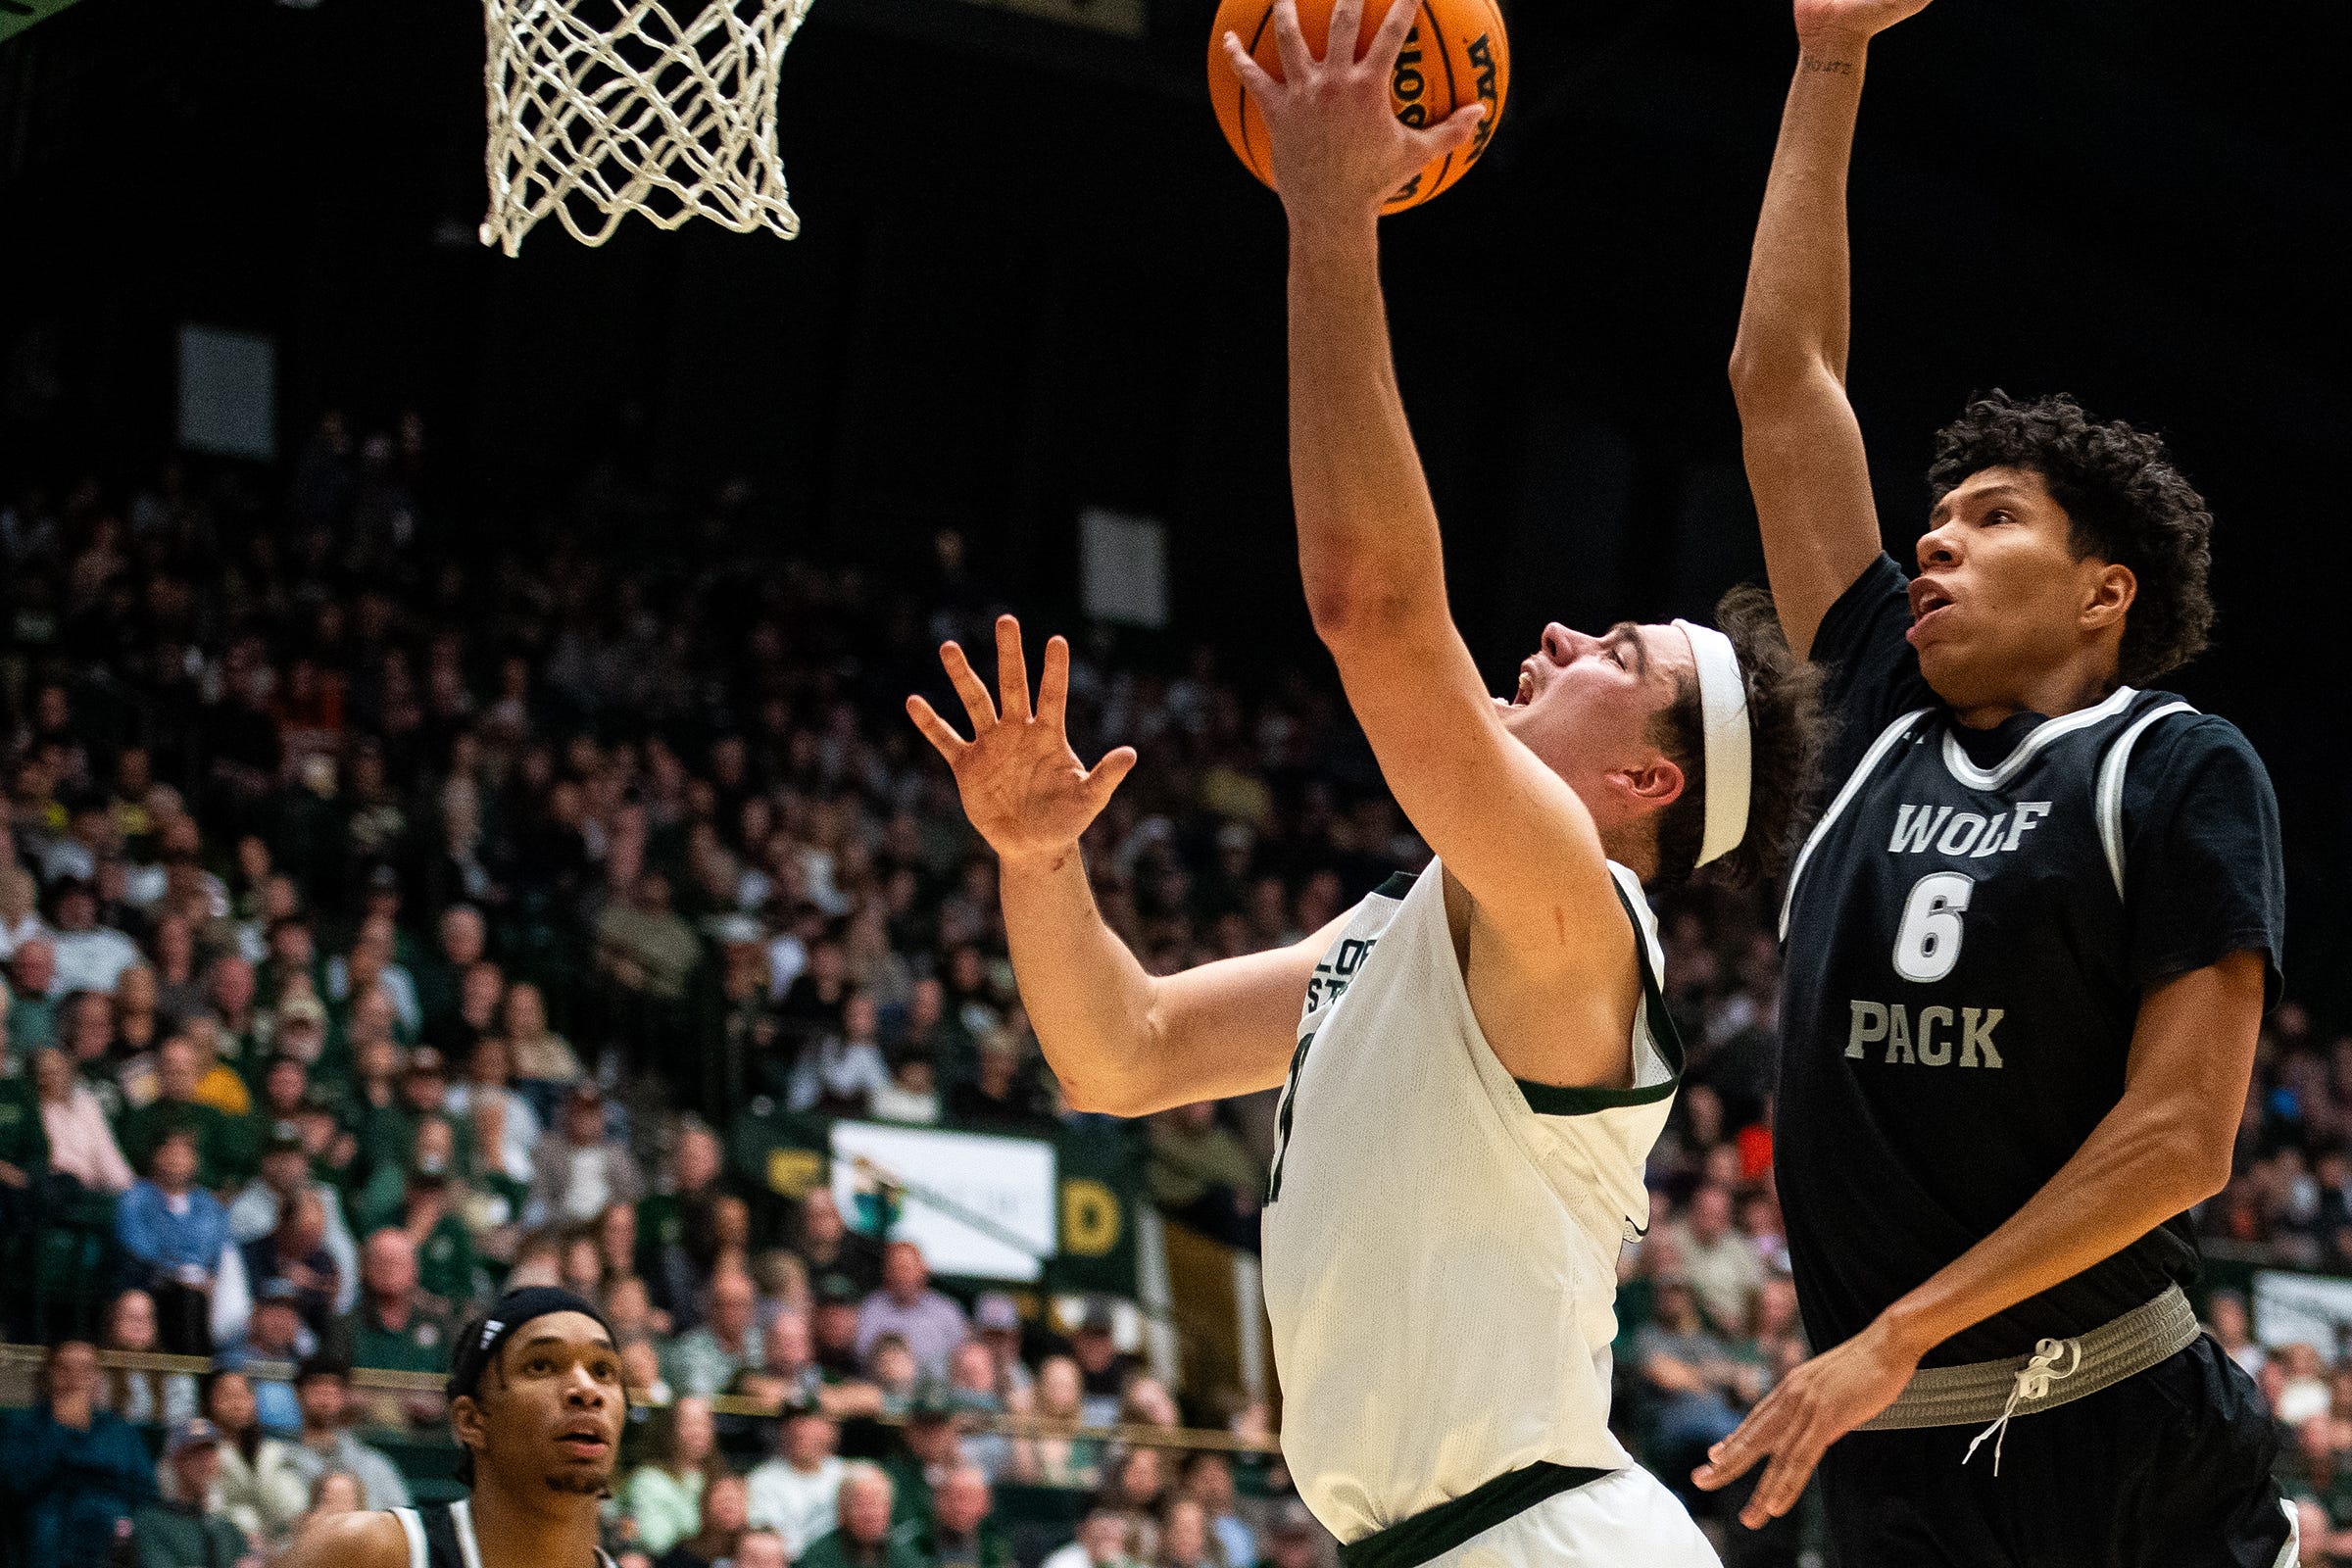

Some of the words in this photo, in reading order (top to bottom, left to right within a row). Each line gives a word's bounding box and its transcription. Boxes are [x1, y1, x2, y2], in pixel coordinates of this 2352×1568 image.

[1888, 801, 2053, 858] WOLF
[1892, 871, 1976, 983] 6
[1844, 1000, 2005, 1069] PACK
